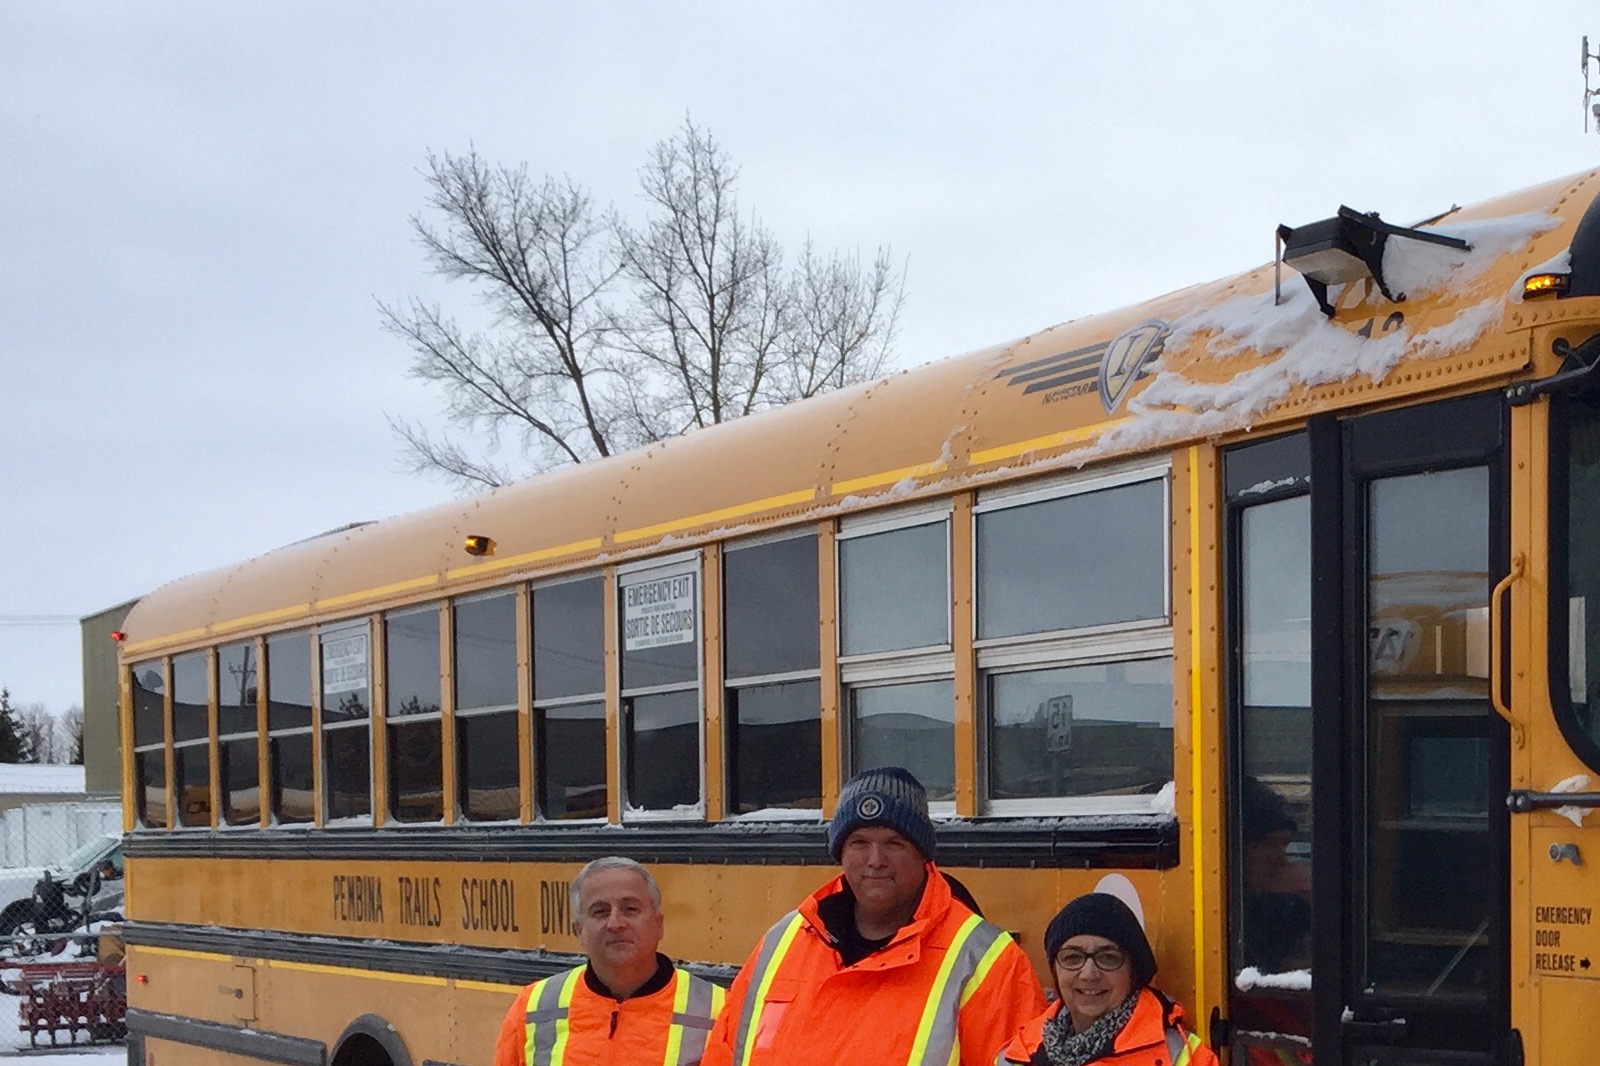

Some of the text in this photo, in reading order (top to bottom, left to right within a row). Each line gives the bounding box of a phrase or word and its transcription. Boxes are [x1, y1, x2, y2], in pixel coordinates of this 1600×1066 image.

[672, 576, 690, 600] EXIT
[333, 874, 385, 923] PEMBINA
[398, 876, 441, 928] TRAILS
[461, 877, 519, 933] SCHOOL
[1535, 906, 1592, 925] EMERGENCY
[1535, 929, 1561, 947] DOOR
[1535, 953, 1576, 972] RELEASE
